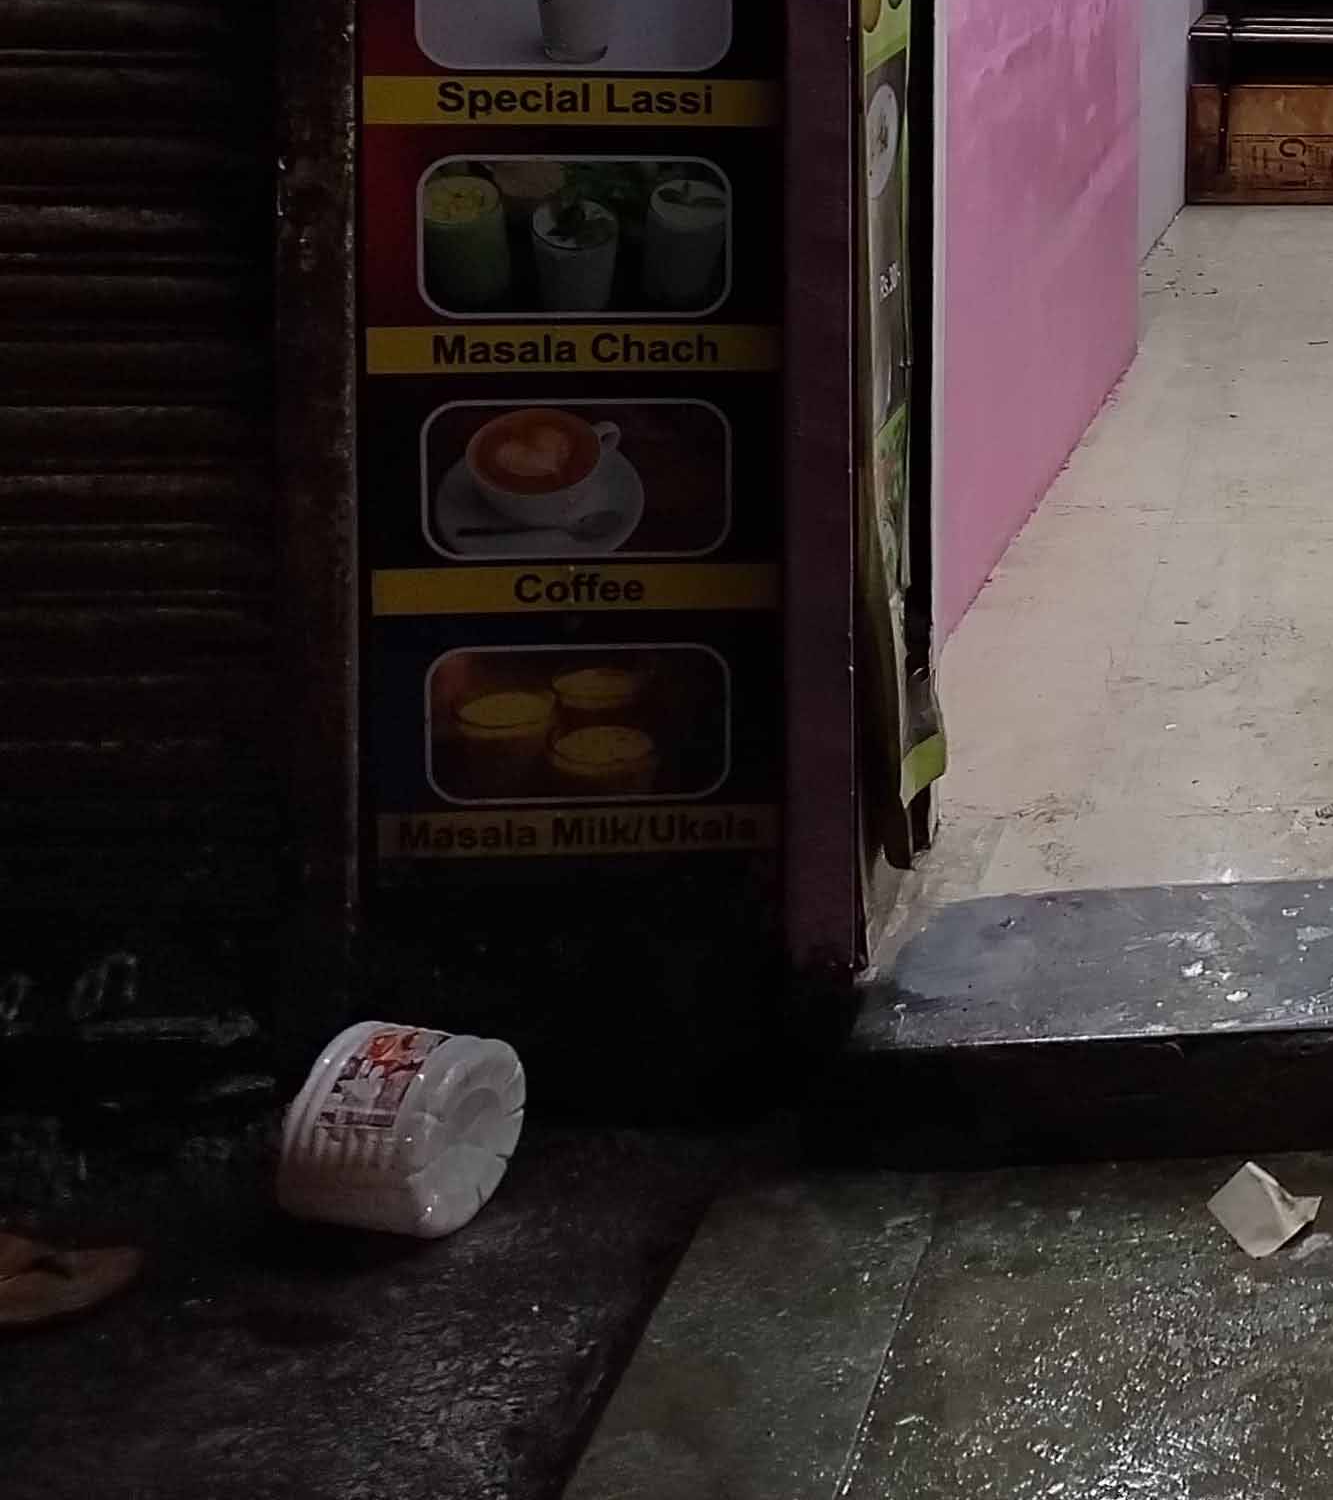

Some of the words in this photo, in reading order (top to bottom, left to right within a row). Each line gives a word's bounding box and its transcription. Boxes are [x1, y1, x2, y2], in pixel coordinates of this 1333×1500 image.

[436, 81, 591, 122] Special
[606, 84, 713, 115] Lassi
[432, 333, 577, 366] Masala
[611, 333, 719, 365] Chach
[514, 573, 645, 604] Coffee
[403, 817, 537, 852] Masala
[552, 813, 758, 849] Milk/Ukala
